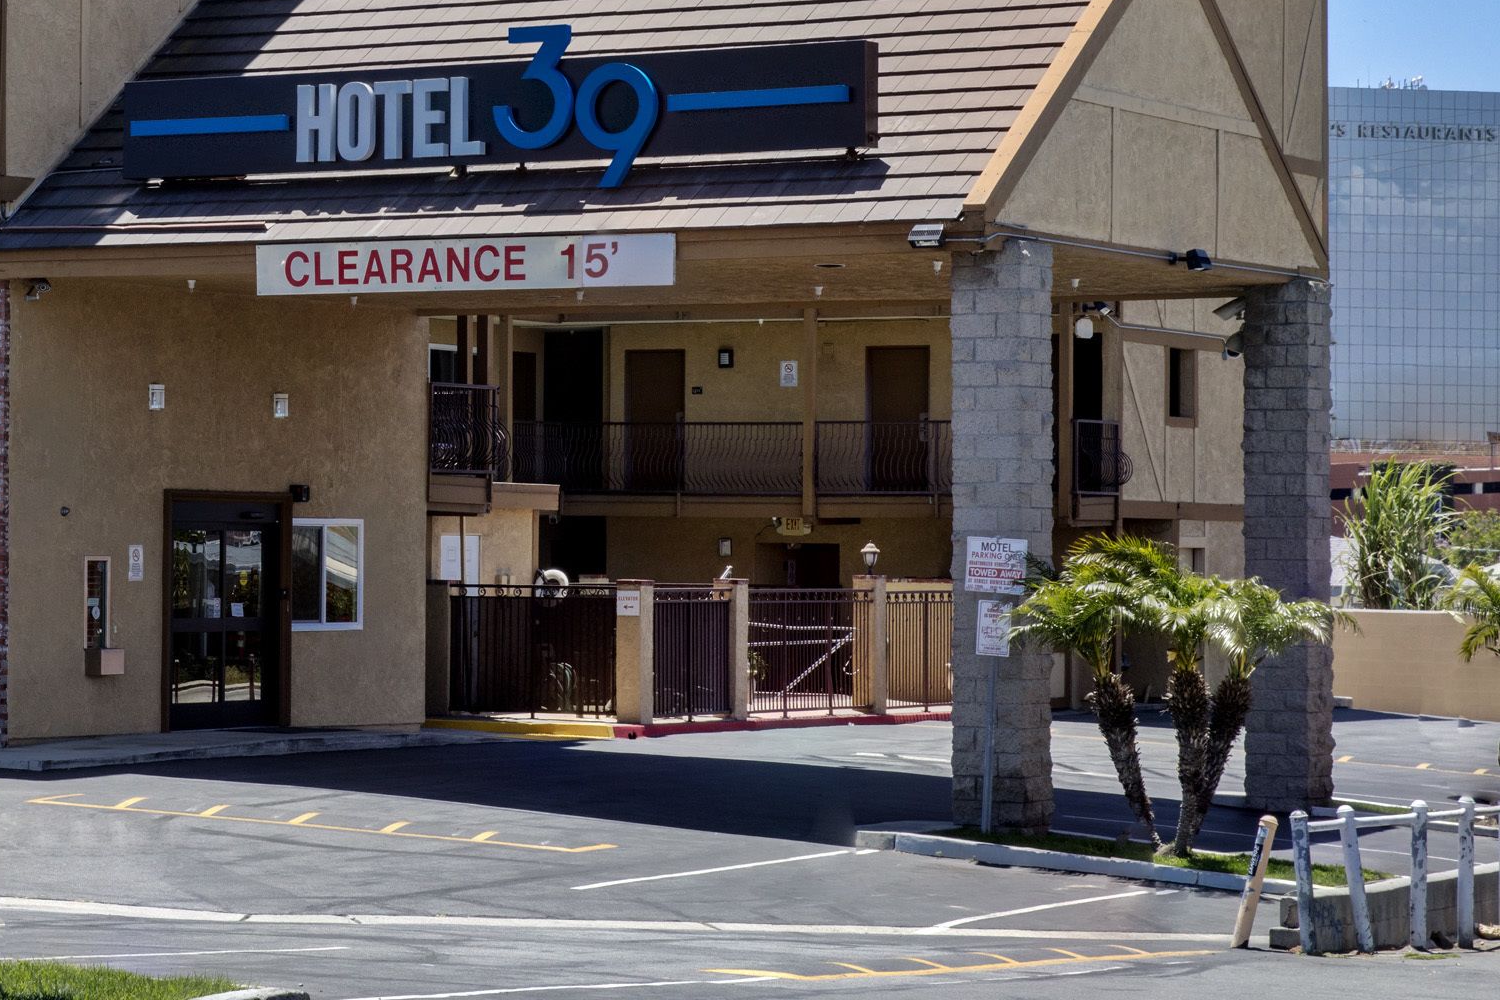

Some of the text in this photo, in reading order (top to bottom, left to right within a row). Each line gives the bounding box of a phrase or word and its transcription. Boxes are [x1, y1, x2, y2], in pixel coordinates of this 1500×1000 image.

[295, 24, 658, 188] HOTEL 39
[1357, 124, 1496, 142] RESTAURANTS
[284, 242, 619, 289] CLEARANCE 15'
[785, 518, 800, 530] EXIT
[981, 542, 1013, 553] MOTEL
[971, 551, 1002, 560] PARKING
[970, 568, 1022, 579] TOWED AWAY
